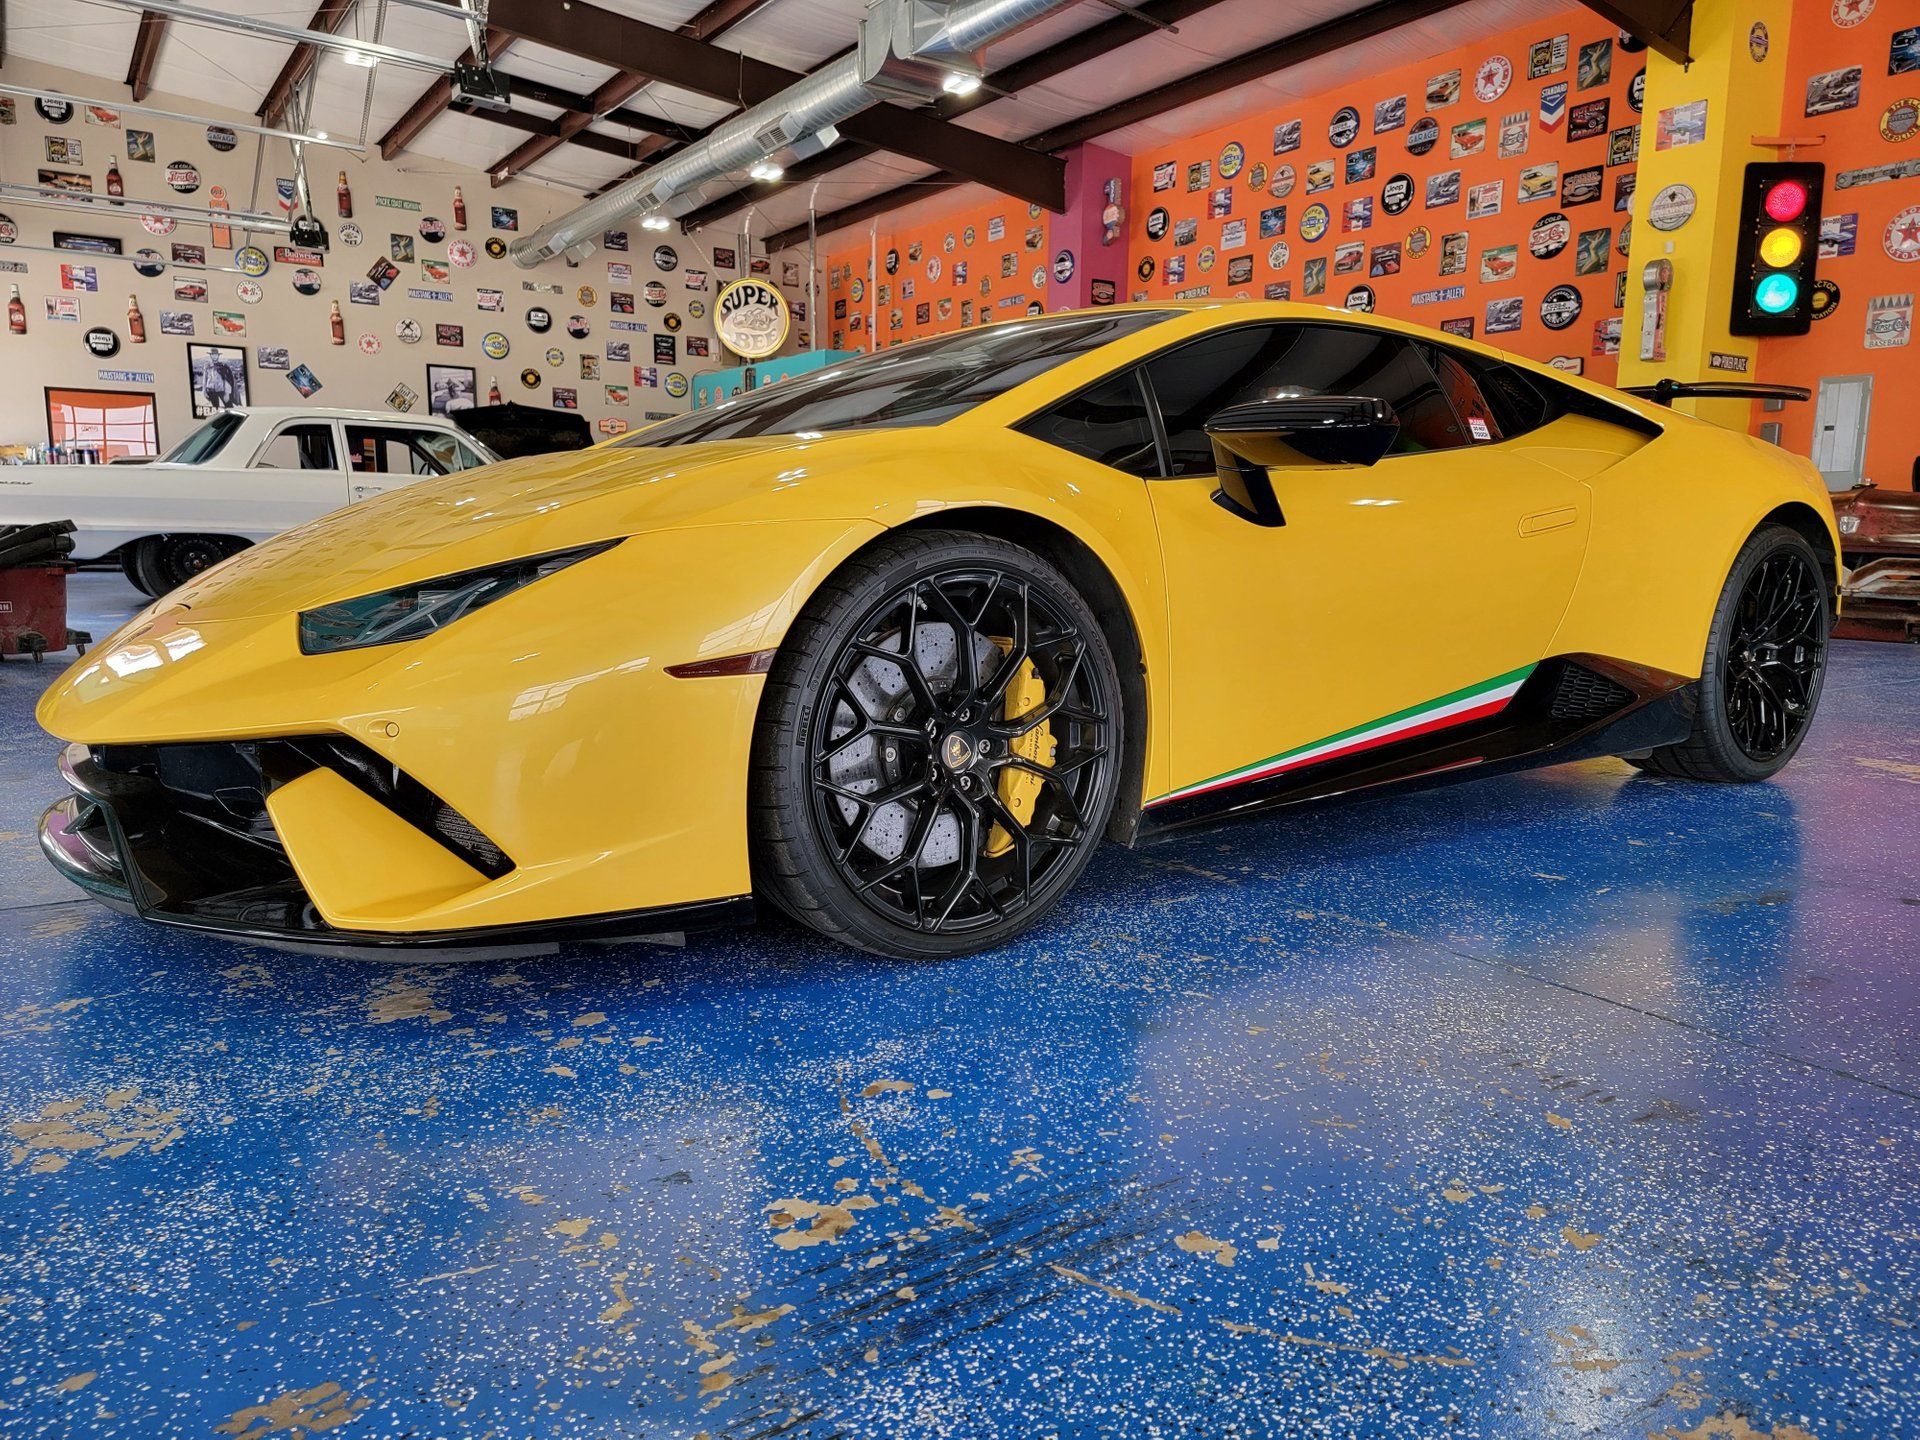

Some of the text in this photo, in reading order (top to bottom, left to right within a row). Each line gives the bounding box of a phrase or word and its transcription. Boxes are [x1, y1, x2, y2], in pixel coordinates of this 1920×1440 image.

[1573, 102, 1605, 118] HOT ROD
[207, 133, 235, 143] GARAGE
[1409, 129, 1437, 143] GARAGE
[1572, 126, 1604, 138] GARAGE
[1387, 184, 1404, 193] Jeep
[376, 196, 391, 206] PACIFIC
[391, 199, 402, 208] COAST
[1544, 215, 1562, 224] COLD
[285, 247, 321, 259] Budweiser
[409, 289, 450, 300] MUSTANG ALLEY
[721, 286, 778, 314] SUPER
[1413, 288, 1463, 304] MUSTANG ALLEY
[1870, 339, 1903, 347] BASEBALL
[99, 370, 153, 382] MUSTANG ALLEY
[796, 704, 812, 747] PIRELLI
